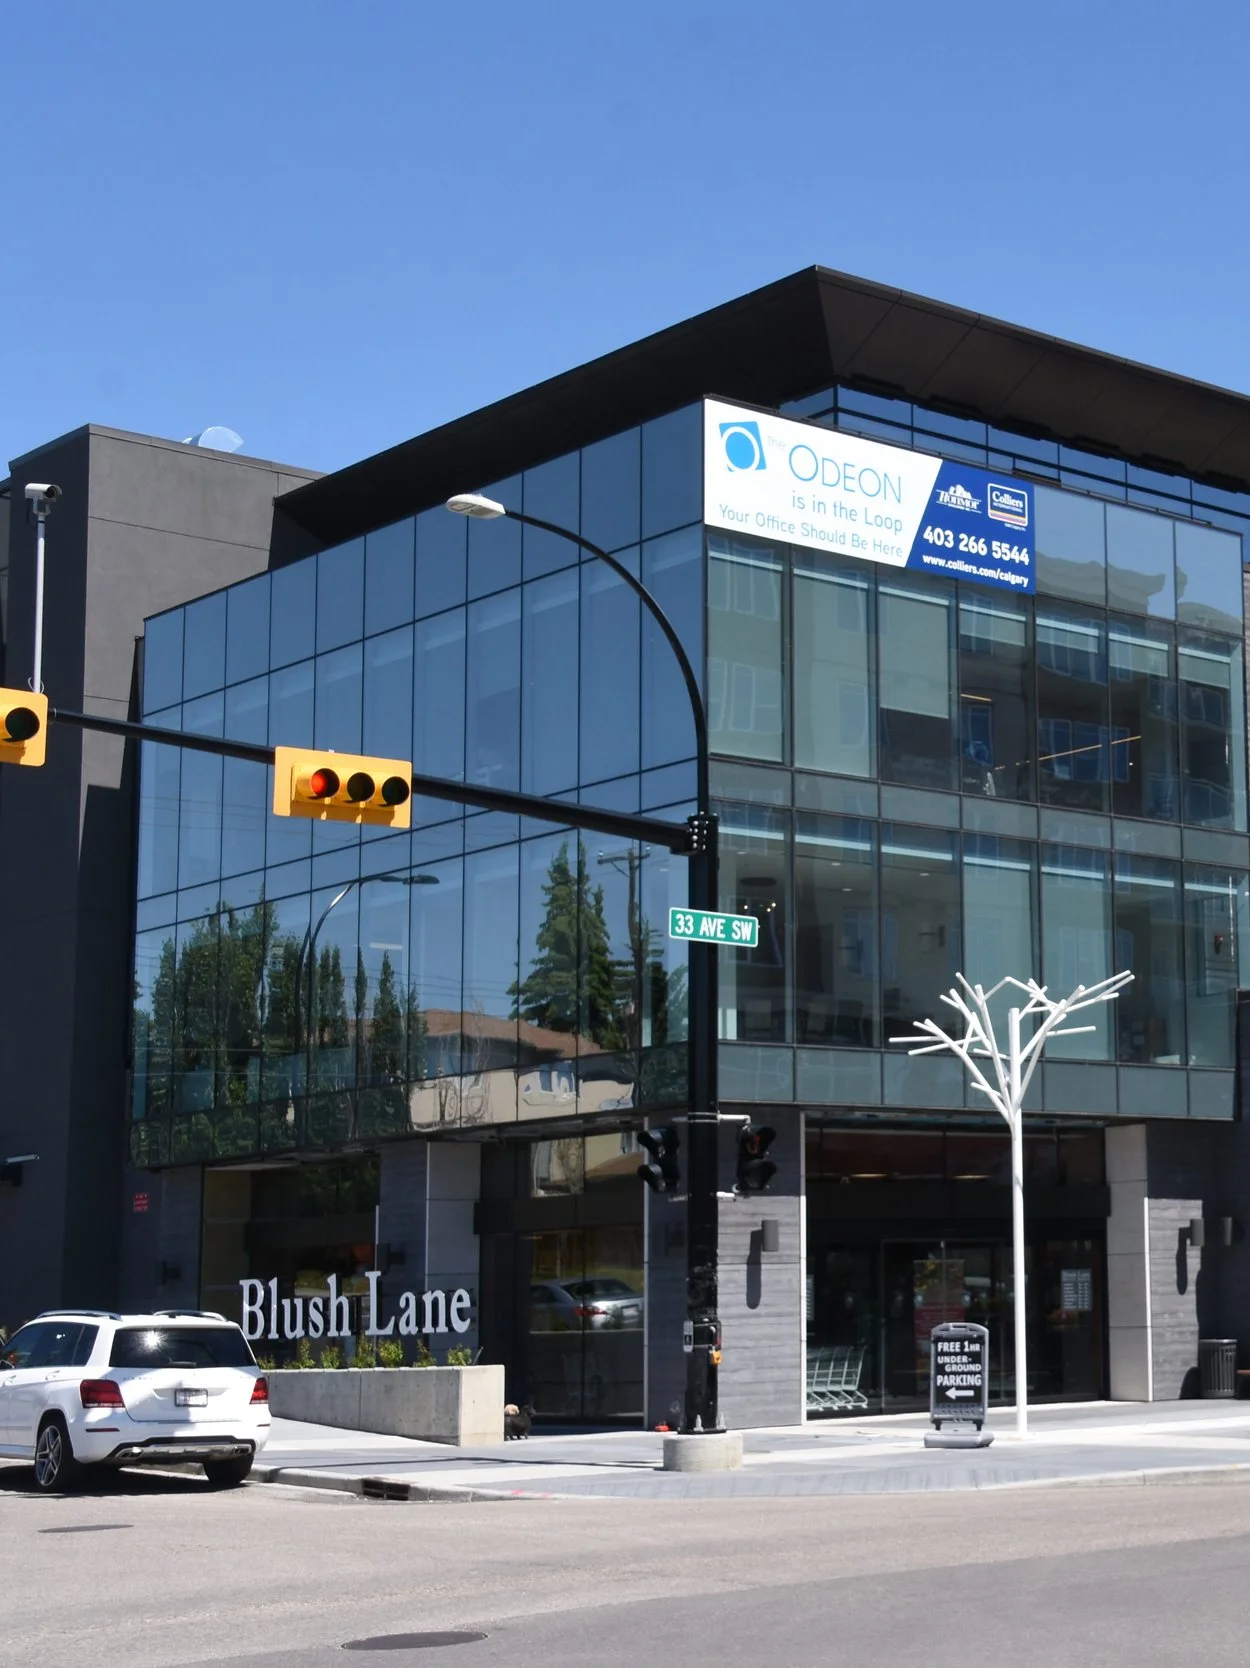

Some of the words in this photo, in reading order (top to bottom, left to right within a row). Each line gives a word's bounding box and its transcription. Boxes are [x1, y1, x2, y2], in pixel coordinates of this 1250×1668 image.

[788, 444, 902, 504] ODEON
[791, 490, 806, 510] is
[811, 494, 827, 515] in
[833, 501, 858, 522] the
[864, 507, 903, 536] Loop
[991, 491, 1024, 508] Colliers
[719, 503, 750, 524] Your
[755, 512, 796, 534] Office
[801, 522, 846, 545] Should
[851, 533, 868, 550] Be
[873, 537, 904, 558] Here
[923, 525, 954, 549] 403
[958, 533, 988, 556] 266
[991, 540, 1030, 566] 5544
[922, 554, 1029, 588] www.colliers.com/calgary
[675, 913, 694, 935] 33
[699, 916, 726, 938] AVE
[731, 920, 753, 941] SW
[239, 1273, 351, 1340] Blush
[365, 1270, 471, 1335] Lane
[937, 1341, 961, 1352] FREE
[937, 1355, 972, 1364] UNDER-
[936, 1374, 982, 1387] PARKING
[944, 1363, 982, 1373] GROUND
